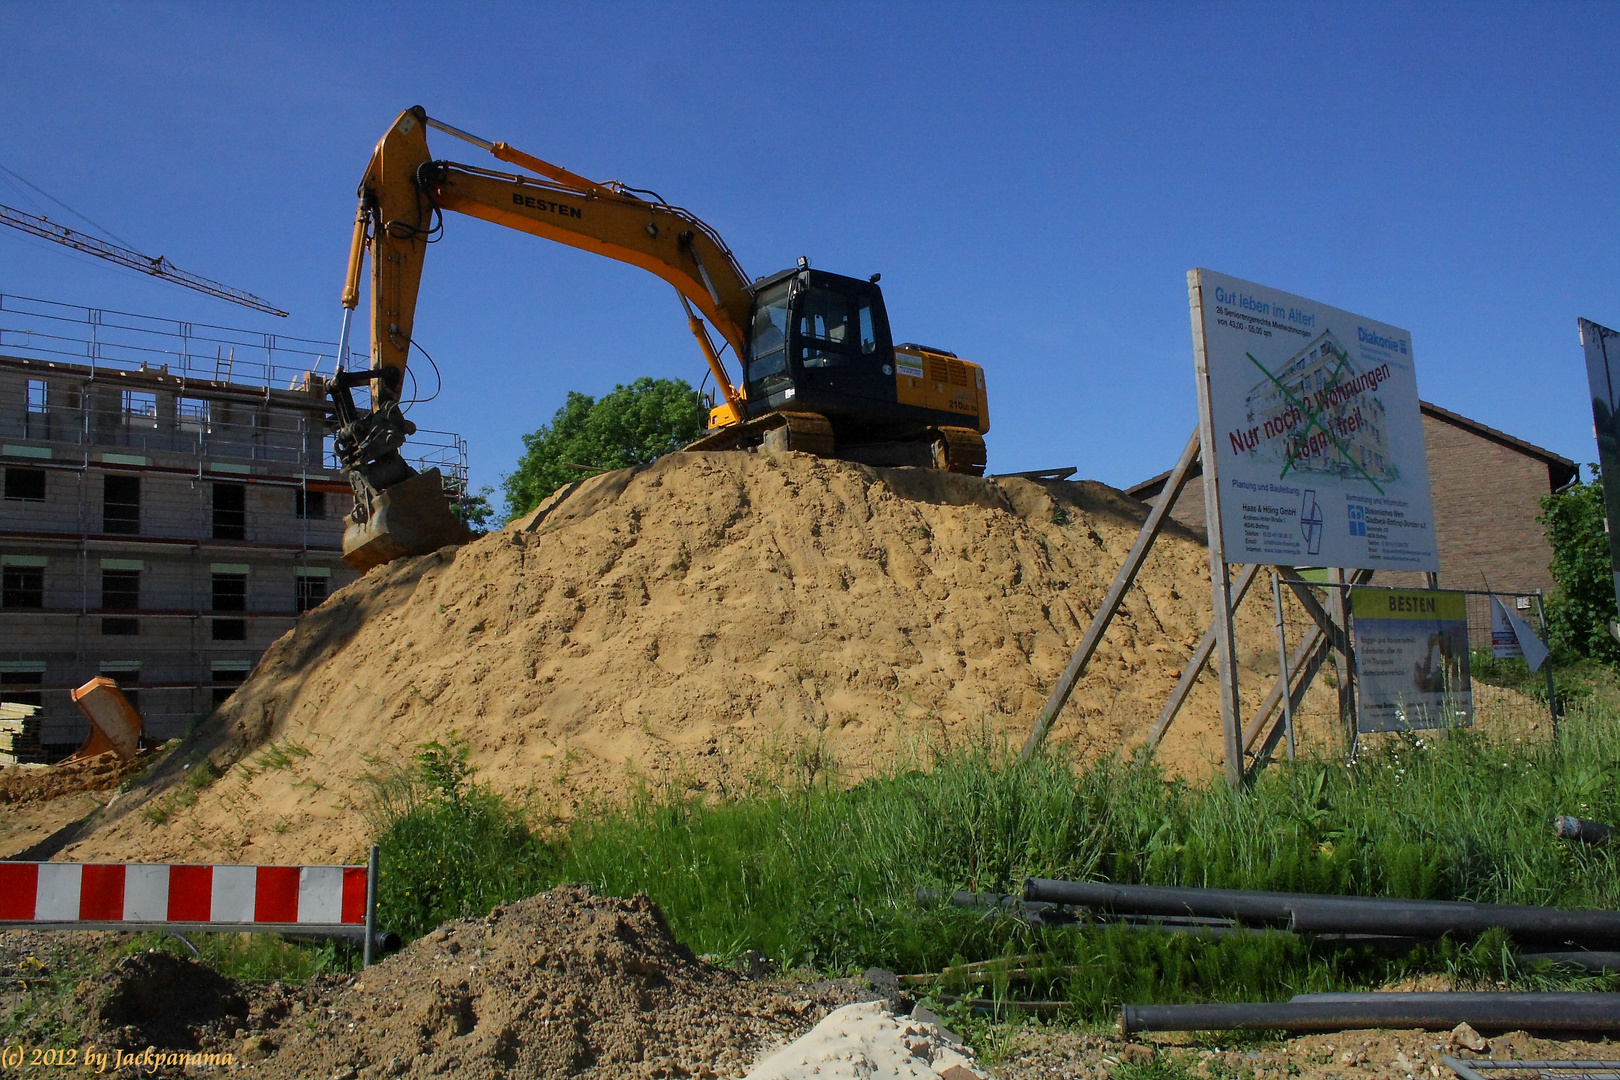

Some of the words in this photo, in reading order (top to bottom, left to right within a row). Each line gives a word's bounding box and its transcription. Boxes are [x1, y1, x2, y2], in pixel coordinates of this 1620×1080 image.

[512, 192, 582, 219] BESTEN
[1215, 286, 1236, 306] Gut
[1239, 293, 1270, 315] leben
[1272, 302, 1286, 319] im
[1288, 307, 1315, 327] Alter!
[1215, 306, 1224, 314] 26
[1224, 308, 1271, 327] Seniorengerechte
[1271, 320, 1312, 338] Mietwohnungen
[1217, 318, 1228, 326] von
[1229, 320, 1244, 330] 43,00
[1357, 326, 1399, 352] Diakonie
[1228, 424, 1260, 456] Nur
[1263, 403, 1302, 440] noch
[1315, 363, 1392, 410] Wohnungen
[1335, 406, 1365, 438] frei!
[1231, 478, 1257, 492] Planung
[1257, 483, 1269, 492] und
[1242, 503, 1257, 513] Haas
[1257, 504, 1263, 513] &
[1279, 507, 1297, 516] GmbH
[1388, 596, 1436, 613] BESTEN
